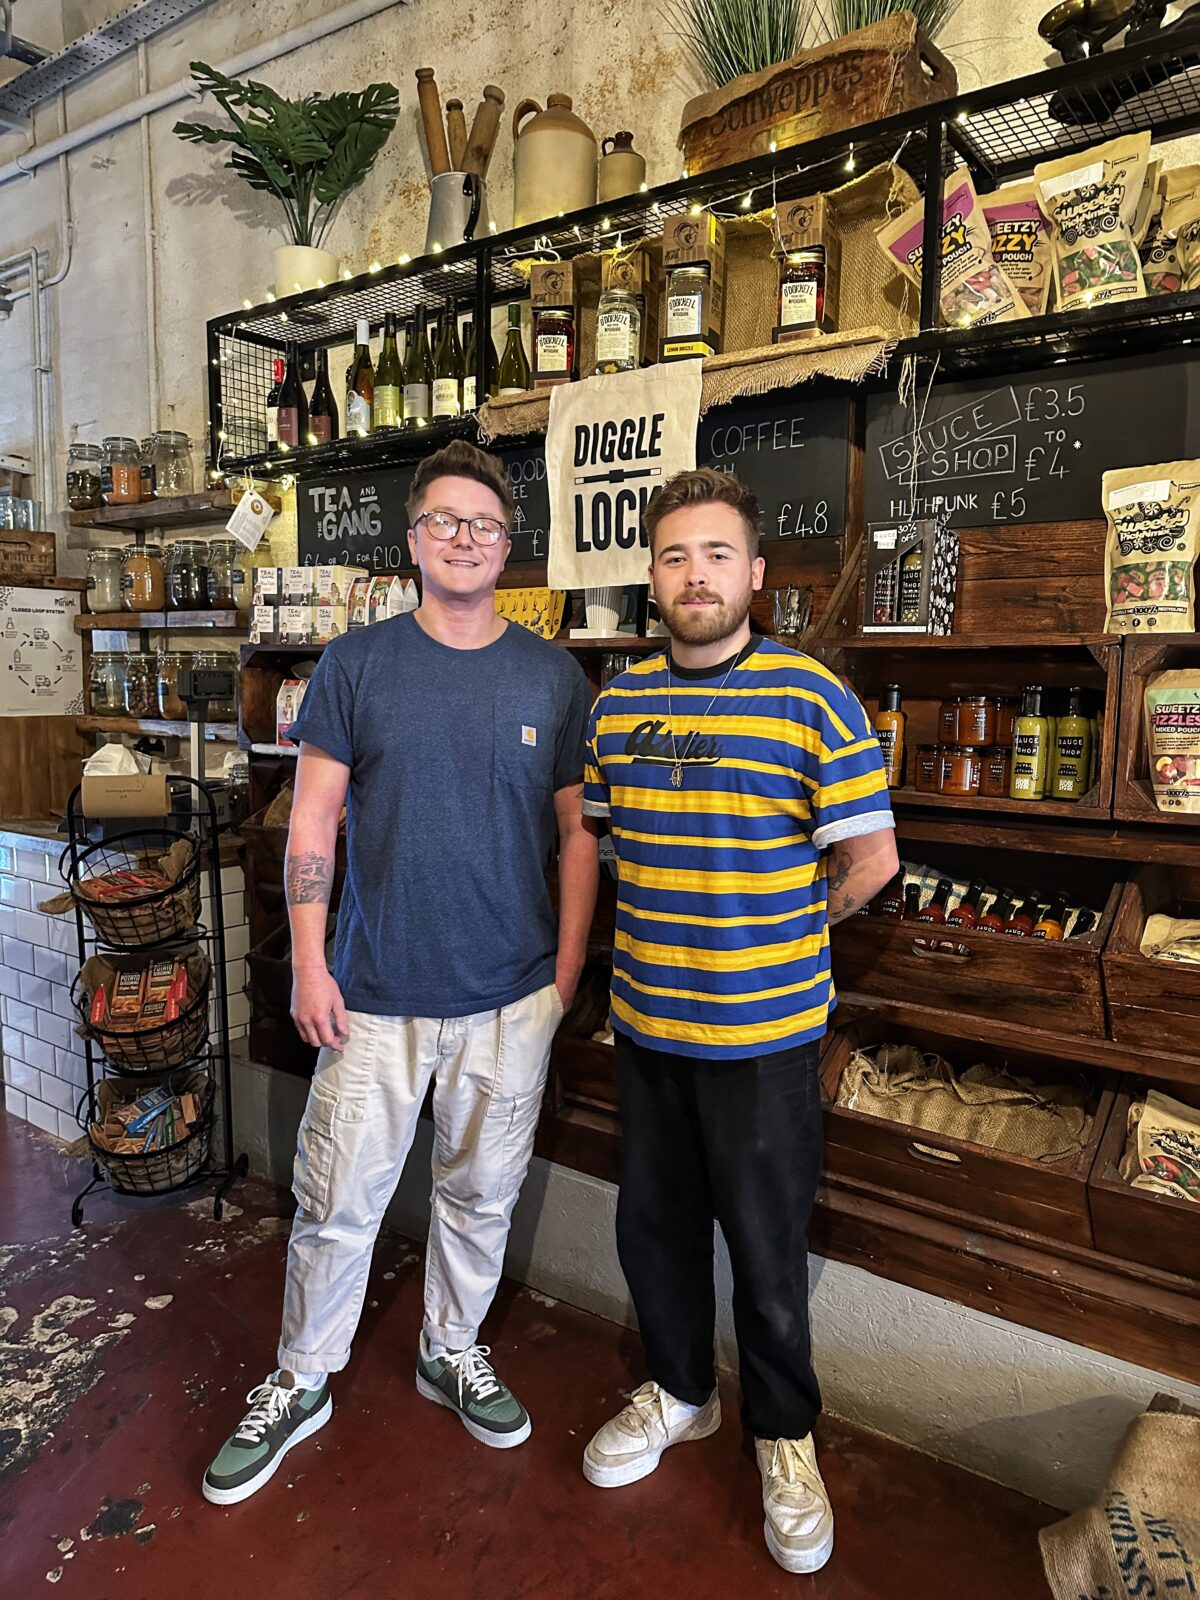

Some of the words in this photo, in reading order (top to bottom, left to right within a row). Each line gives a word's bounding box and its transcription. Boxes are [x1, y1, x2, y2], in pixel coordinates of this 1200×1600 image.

[991, 234, 1036, 251] IZZY
[1002, 252, 1032, 261] POUCH
[1025, 385, 1085, 422] £3.5
[574, 413, 665, 467] DIGGLE
[711, 417, 805, 458] COFFEE
[892, 405, 992, 470] SAUCE
[1044, 429, 1066, 443] TO
[931, 444, 1009, 476] SHOP
[1024, 447, 1070, 482] £4
[309, 486, 352, 513] TEA
[360, 486, 376, 496] AND
[991, 488, 1027, 520] £5
[322, 503, 382, 541] GANG
[778, 501, 828, 537] £4.8
[898, 522, 917, 534] 30%
[901, 532, 917, 542] OFF
[356, 553, 370, 563] FOR
[373, 545, 401, 570] £10
[1156, 705, 1200, 714] SWEETZ
